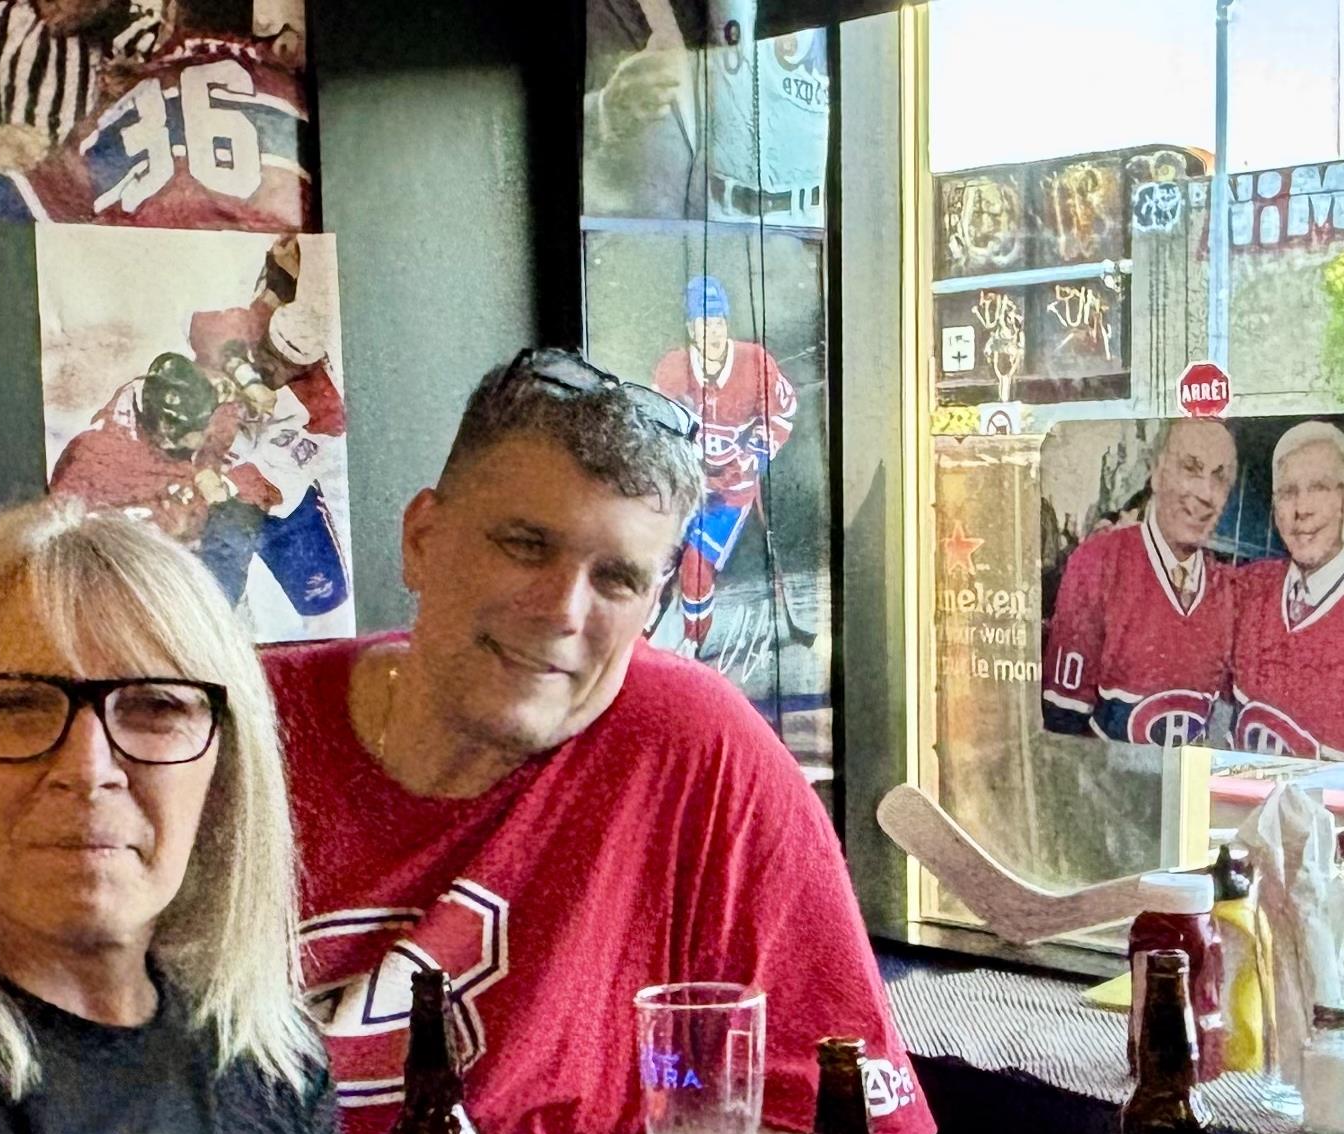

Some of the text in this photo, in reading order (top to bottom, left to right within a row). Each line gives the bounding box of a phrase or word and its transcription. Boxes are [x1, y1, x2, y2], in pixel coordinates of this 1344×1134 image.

[96, 59, 262, 214] 36
[1182, 378, 1227, 403] ARRÊT
[1054, 645, 1084, 690] 10
